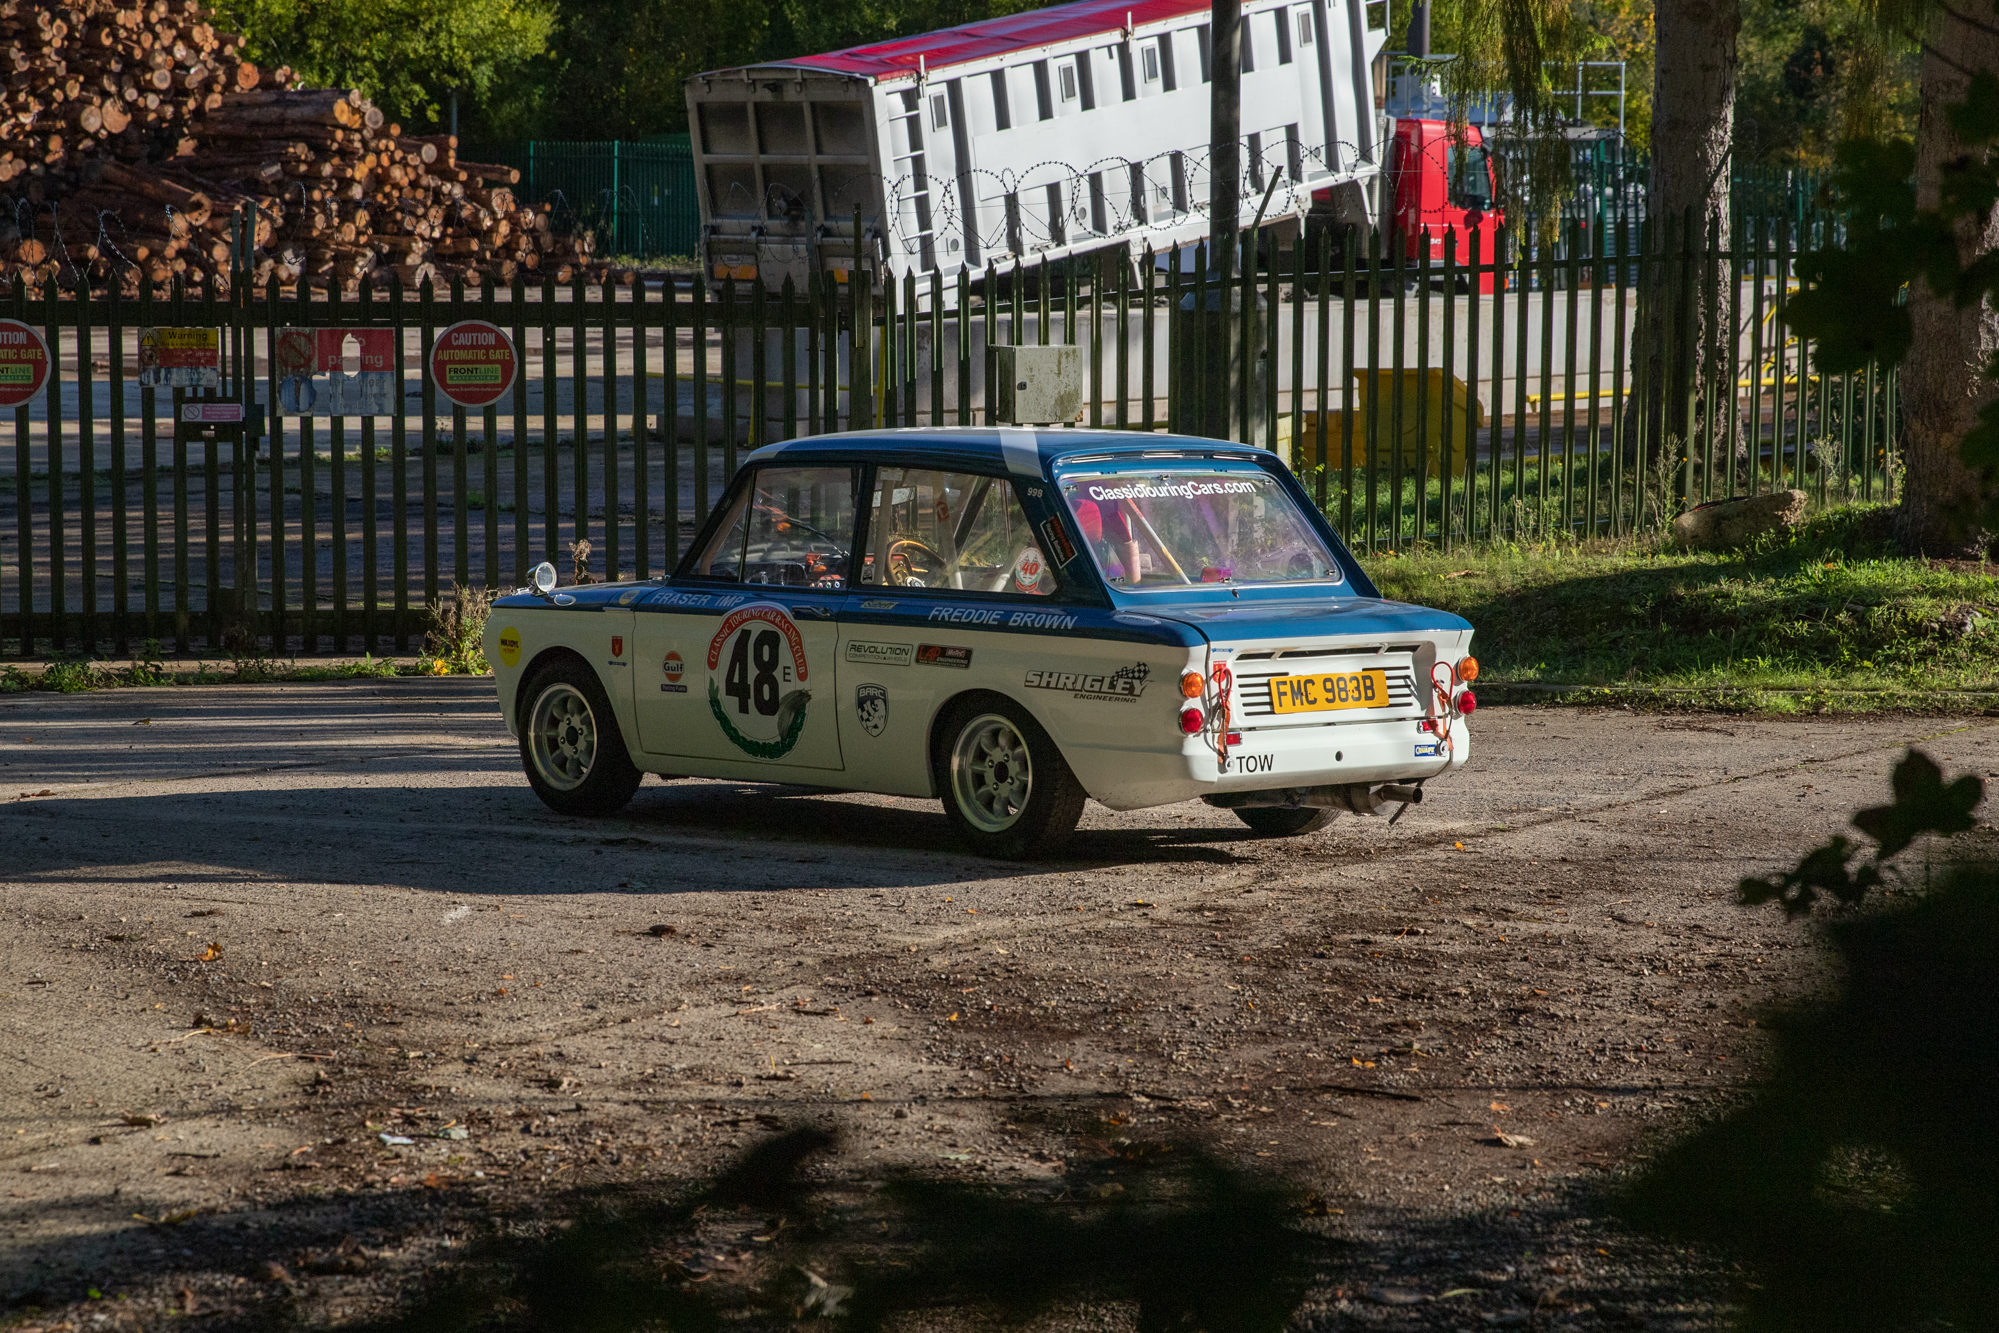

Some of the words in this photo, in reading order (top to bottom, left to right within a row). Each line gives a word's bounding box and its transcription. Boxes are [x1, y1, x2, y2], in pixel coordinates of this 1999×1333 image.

[0, 332, 27, 345] TION
[168, 331, 208, 342] Warning
[451, 332, 496, 346] CAUTION
[20, 348, 42, 360] GATE
[328, 354, 383, 367] paing
[437, 349, 487, 361] AUTOMATIC
[489, 349, 510, 360] GATE
[448, 366, 499, 375] FRONTLINE
[1027, 487, 1044, 498] 998
[1089, 481, 1257, 501] ClassicTouringCars.com
[1021, 561, 1039, 576] 40
[650, 592, 712, 606] FRASER
[714, 595, 745, 607] IMP
[928, 606, 1004, 625] FREDDIE
[1008, 612, 1079, 630] BROWN
[710, 623, 732, 662] CLASSIC
[729, 608, 761, 628] TOURING
[761, 608, 776, 621] CAR
[775, 615, 800, 646] RACING
[793, 645, 806, 674] CLUB
[849, 644, 910, 656] REVOLUTION
[663, 661, 683, 672] Gulf
[936, 656, 969, 664] ENGINEERING
[725, 629, 781, 716] 48
[783, 666, 791, 682] E
[1024, 669, 1153, 697] SHRIGLEY
[859, 687, 884, 699] BARC
[1276, 679, 1317, 707] FMC
[1322, 675, 1376, 704] 983B
[1073, 693, 1137, 703] ENGINEERING
[1236, 754, 1274, 773] TOW
